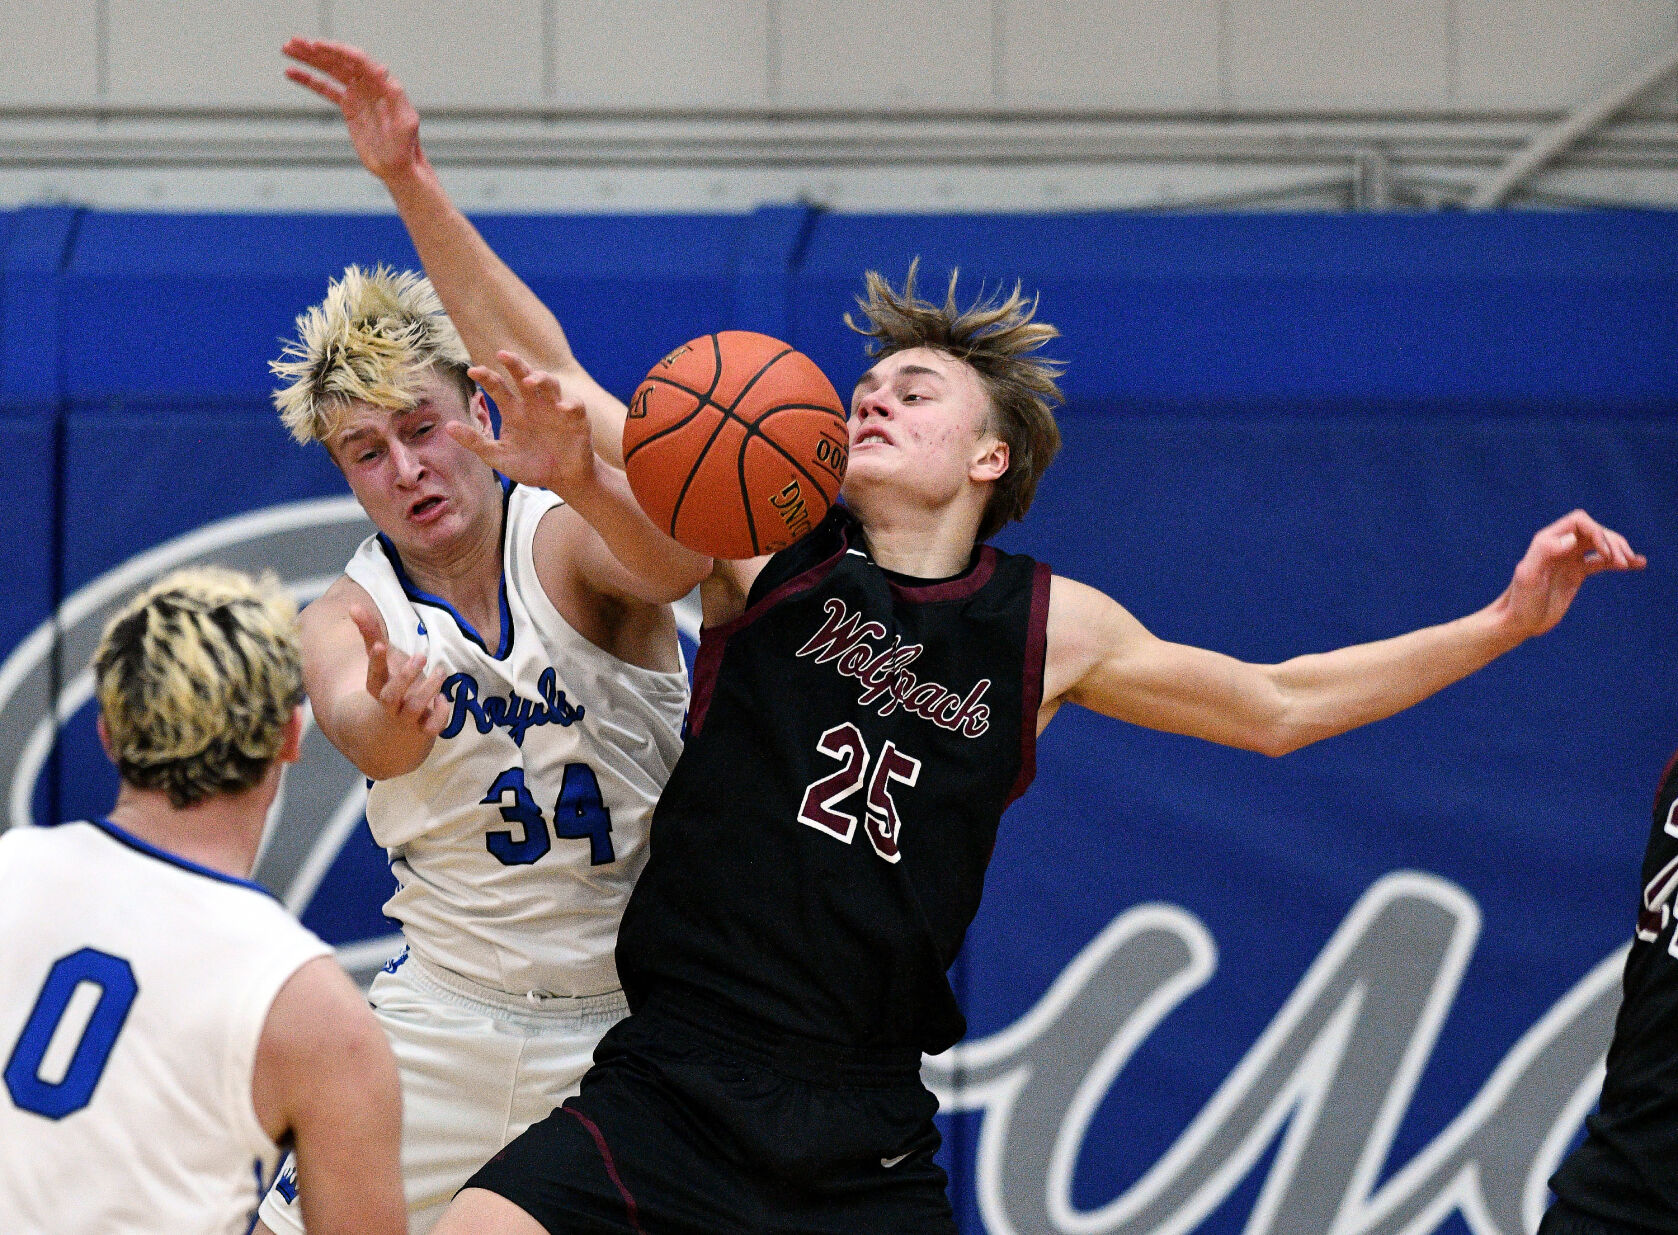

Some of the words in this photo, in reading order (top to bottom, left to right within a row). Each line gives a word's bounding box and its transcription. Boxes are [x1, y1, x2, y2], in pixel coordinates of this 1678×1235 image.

[439, 667, 586, 749] Royals
[478, 763, 616, 867] 34
[797, 721, 922, 864] 25
[3, 946, 139, 1121] 0
